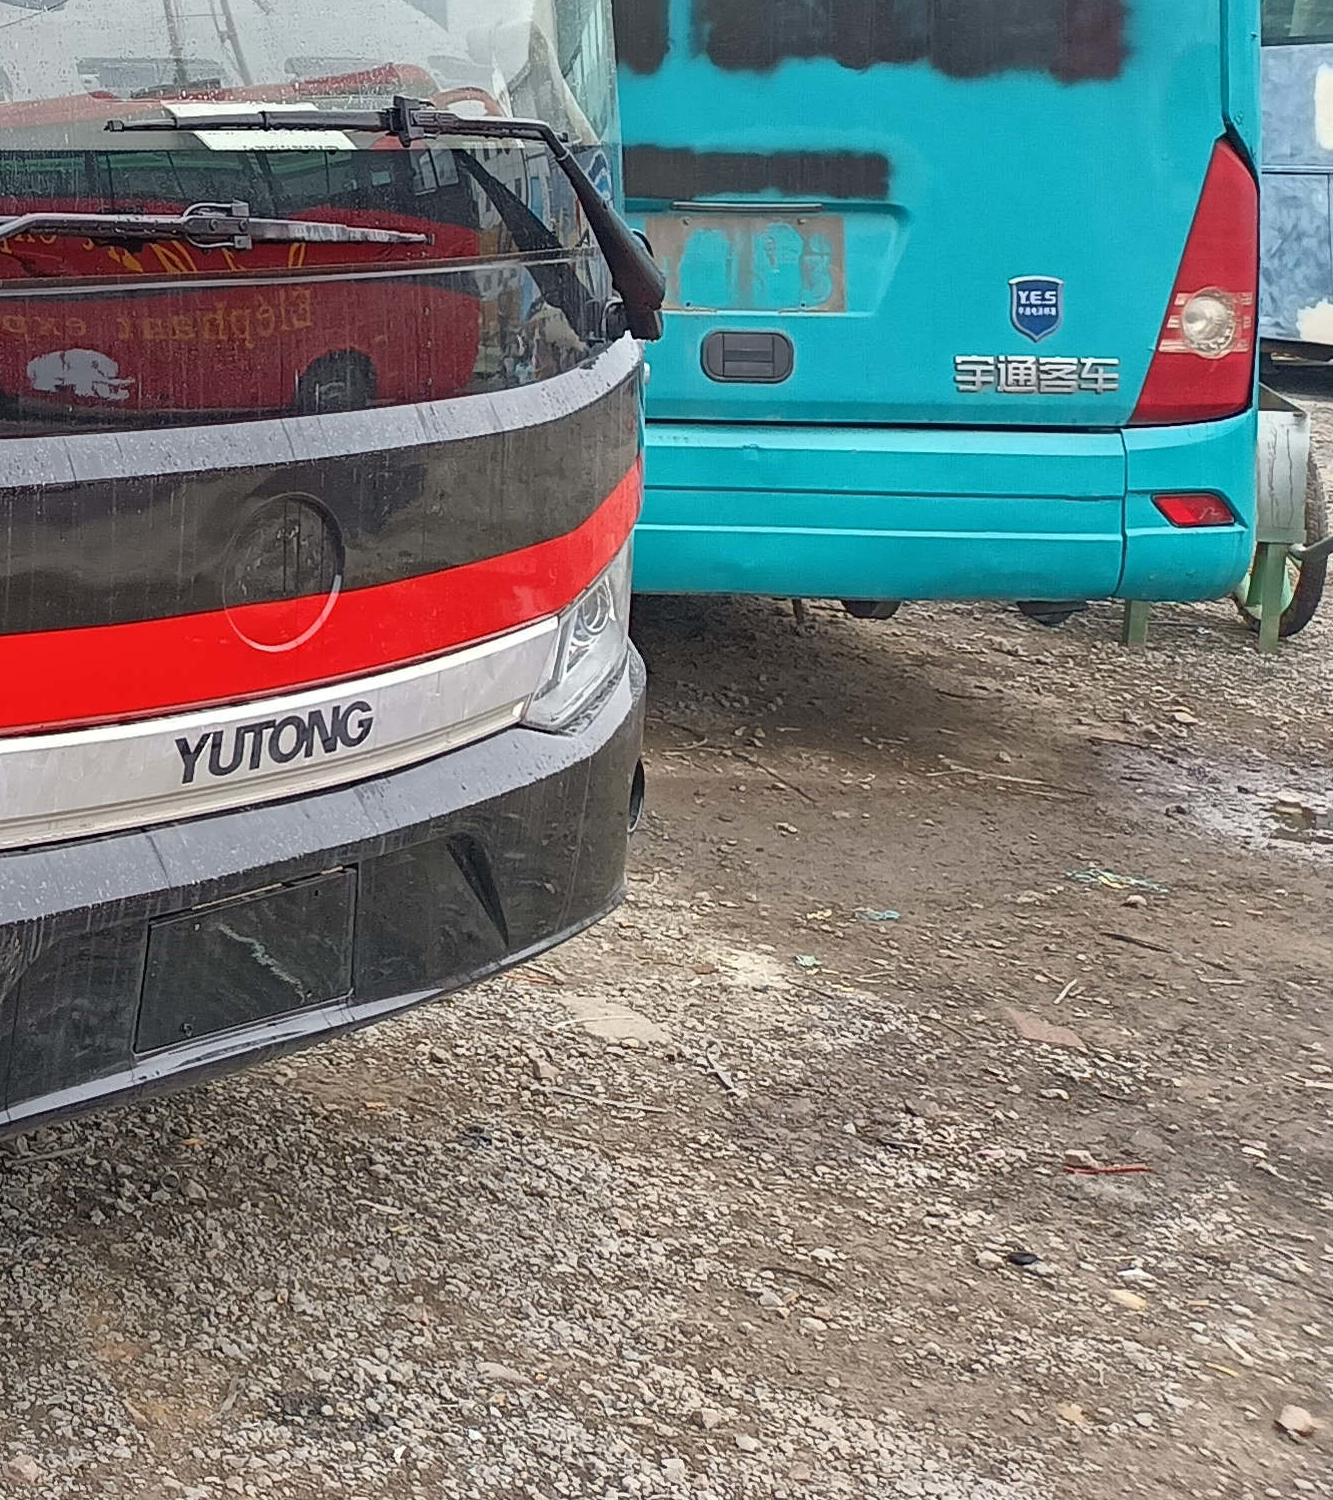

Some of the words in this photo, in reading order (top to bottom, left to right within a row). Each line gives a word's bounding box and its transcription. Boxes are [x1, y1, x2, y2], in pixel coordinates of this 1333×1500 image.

[953, 355, 1120, 394] 宇通客车
[175, 700, 374, 785] YUTONG
